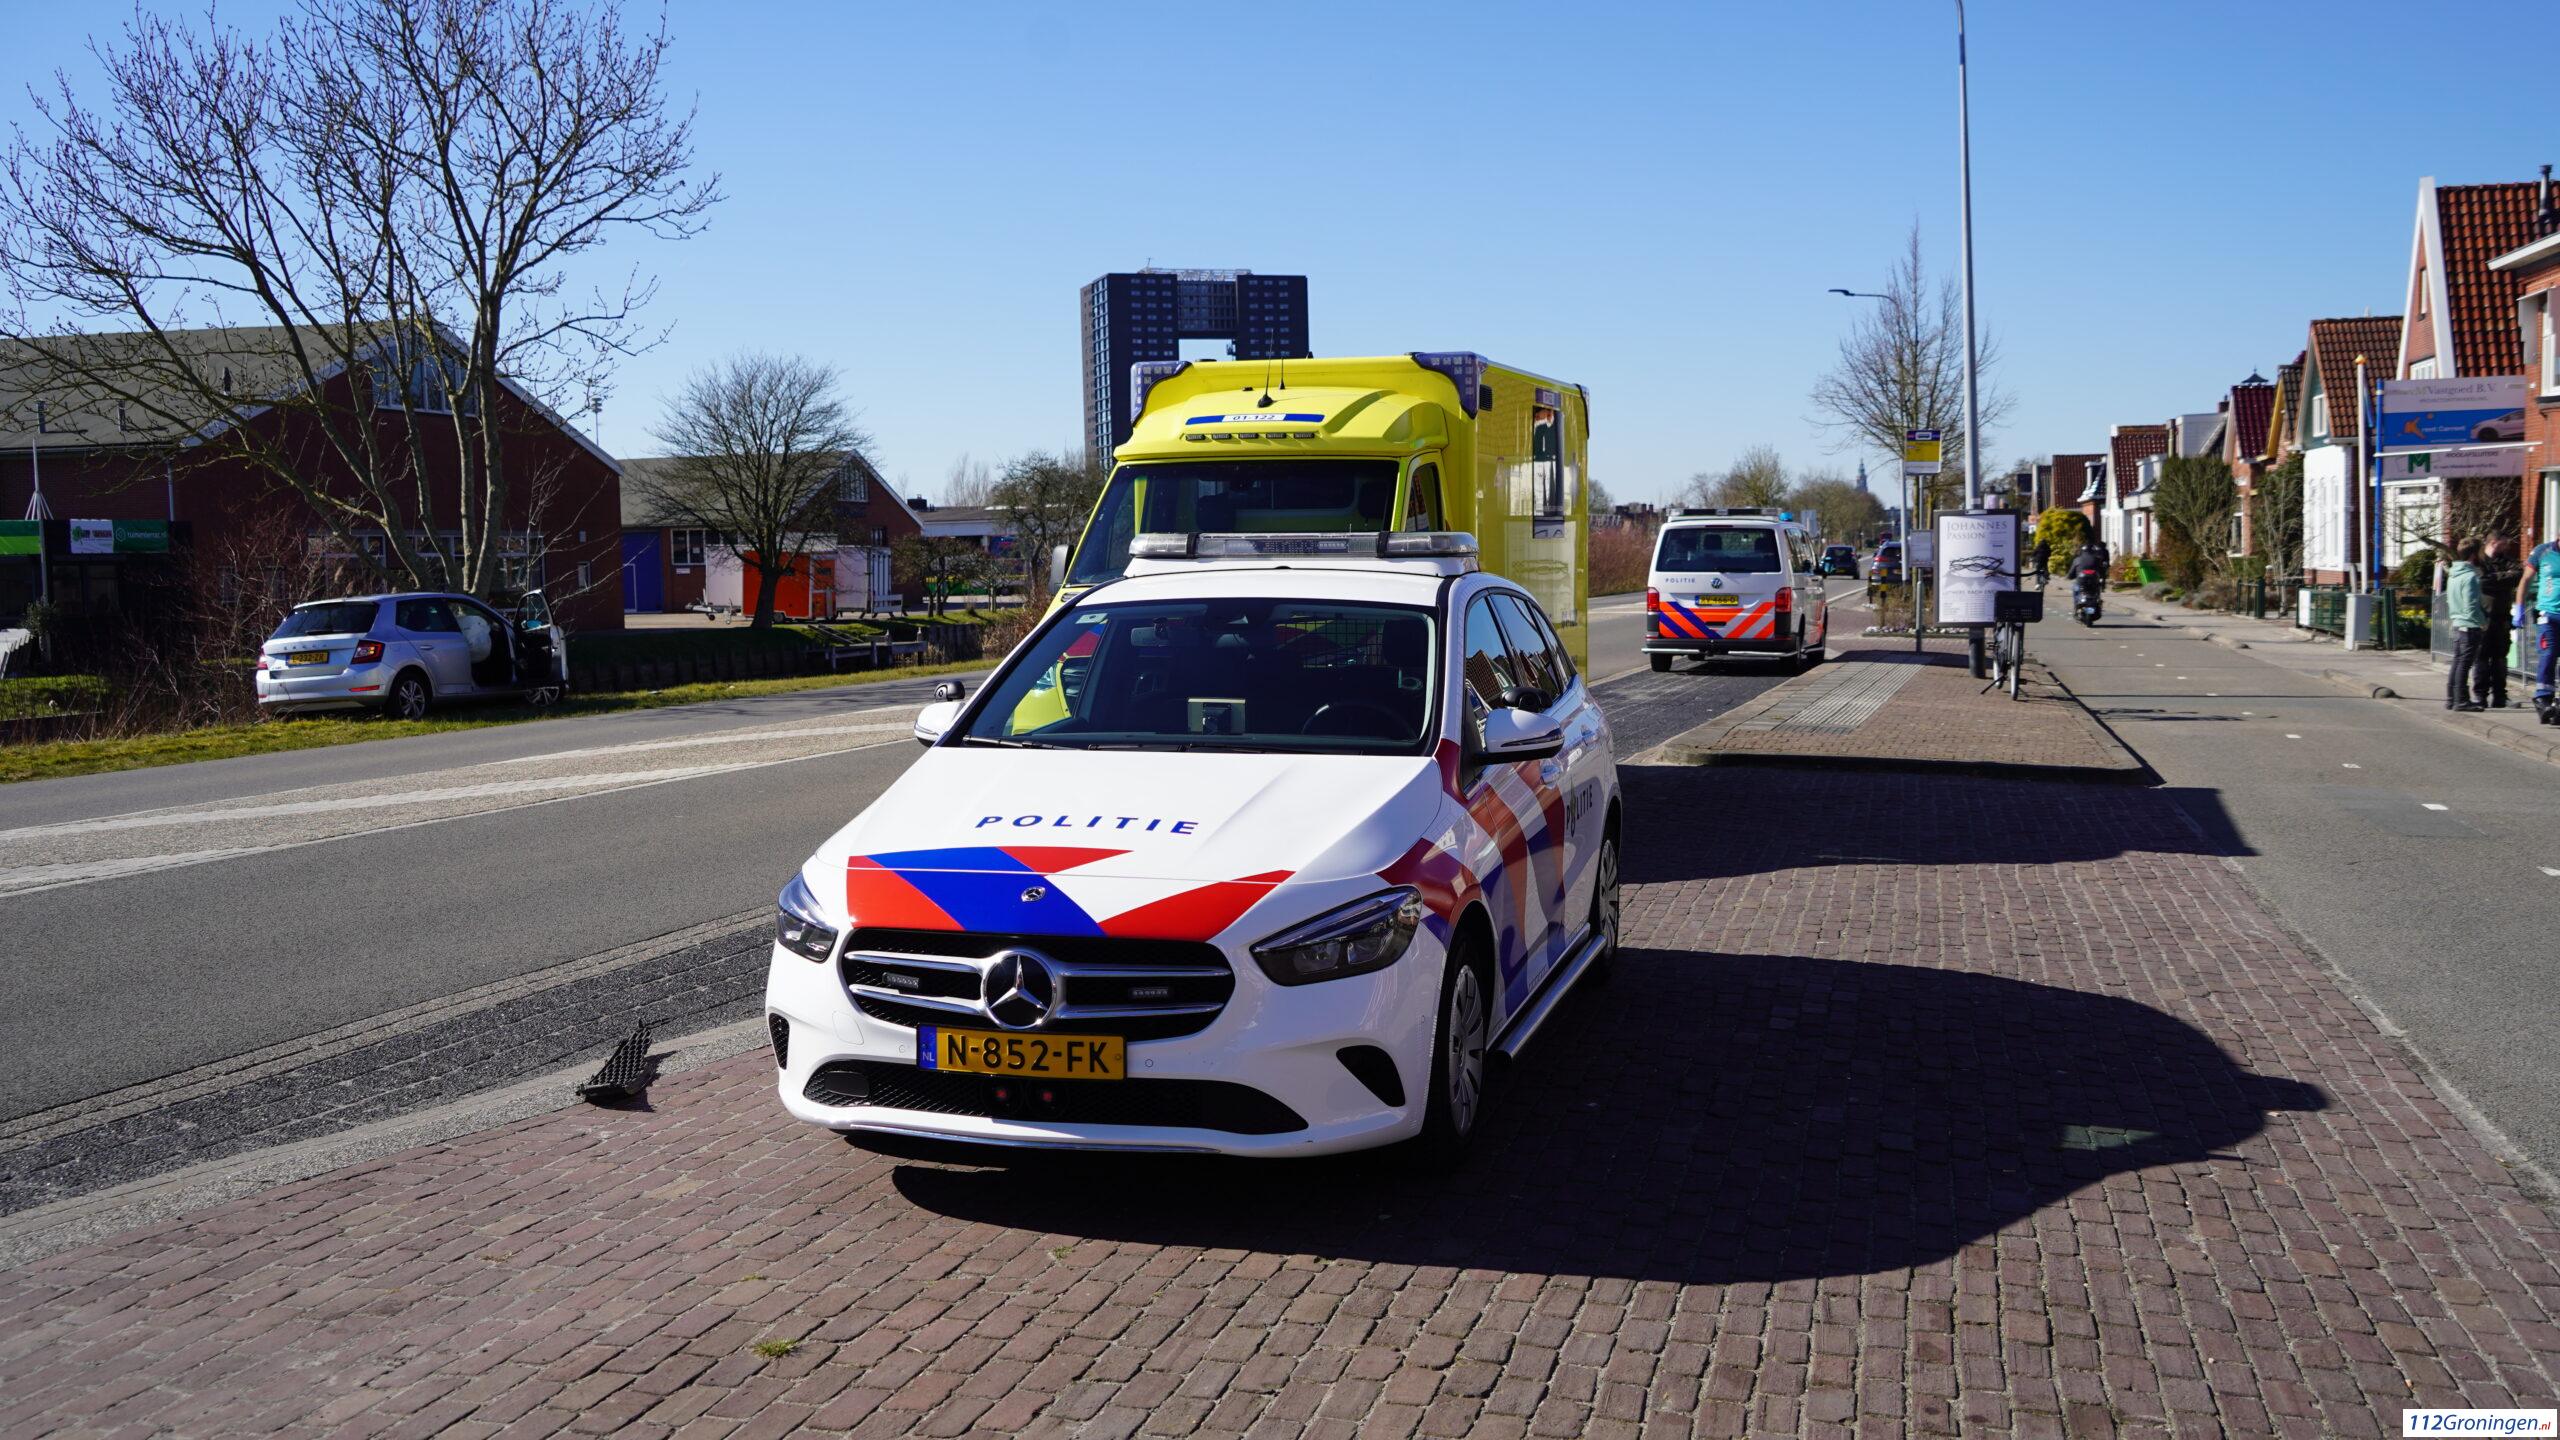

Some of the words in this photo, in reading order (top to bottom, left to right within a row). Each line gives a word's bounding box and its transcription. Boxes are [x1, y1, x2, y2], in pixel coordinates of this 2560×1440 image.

[1947, 520, 2008, 533] JOHANNES
[1947, 532, 1986, 540] PASSION
[975, 815, 1199, 835] POLITIE
[922, 1051, 935, 1062] NL
[947, 1033, 1110, 1074] N-852-FK
